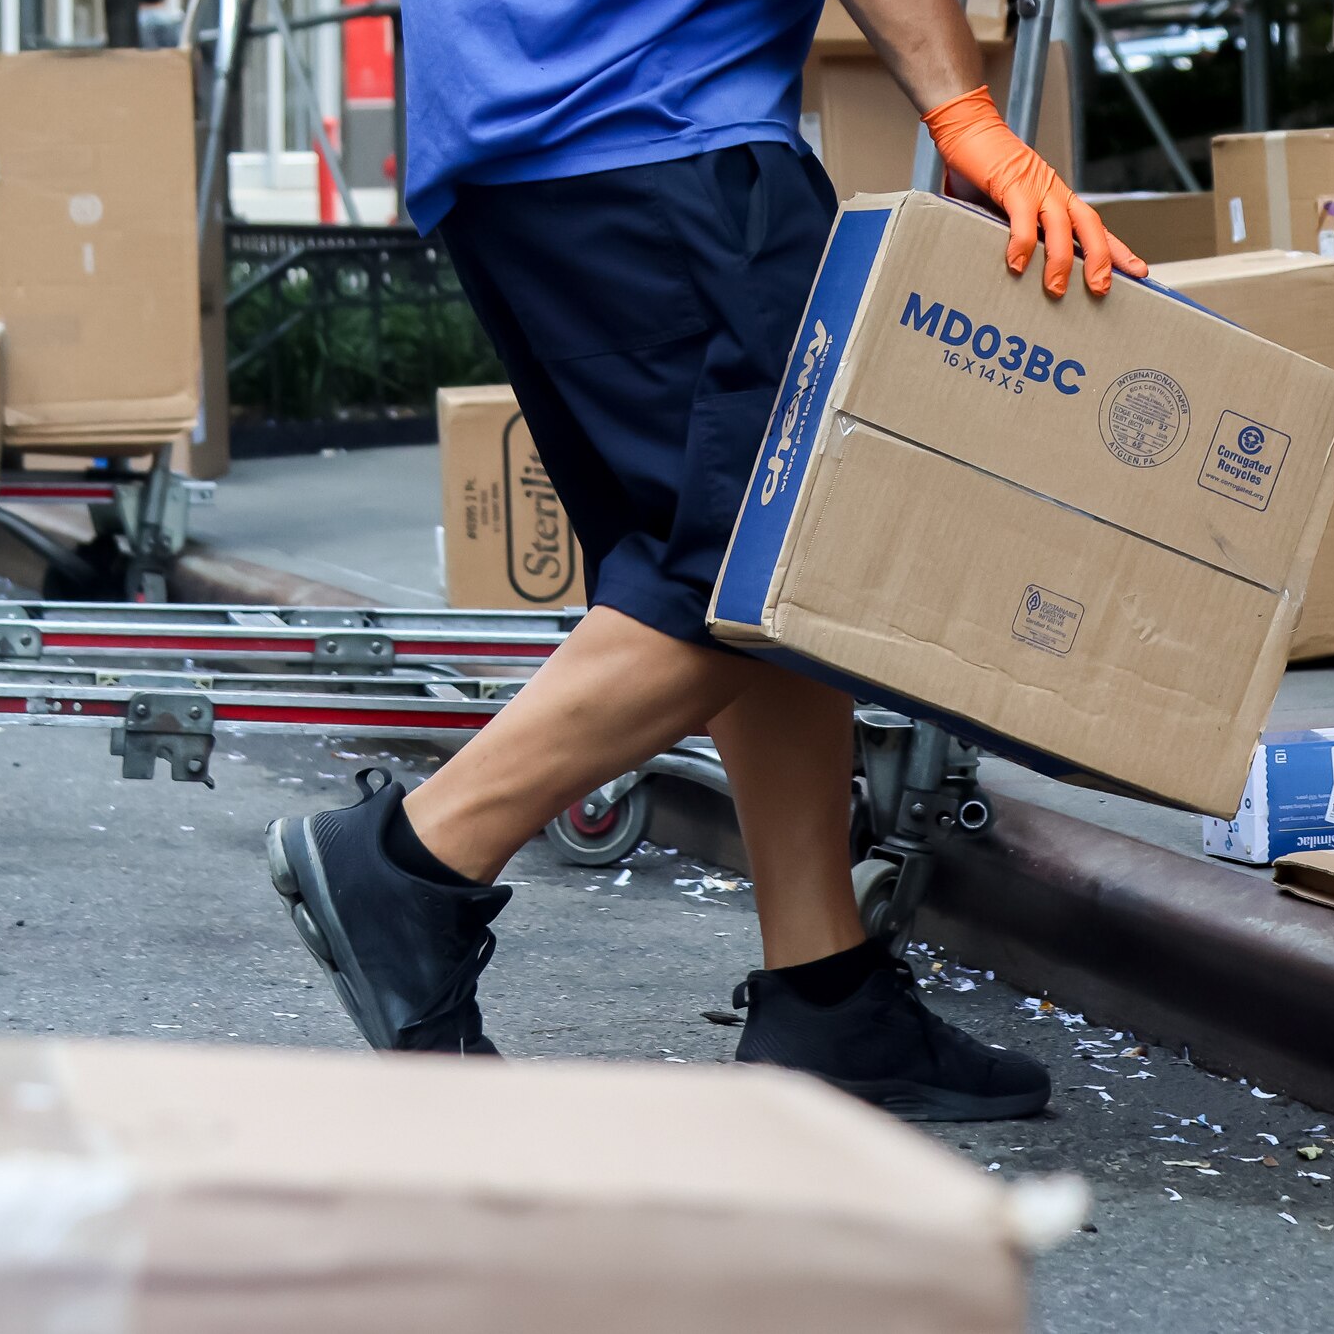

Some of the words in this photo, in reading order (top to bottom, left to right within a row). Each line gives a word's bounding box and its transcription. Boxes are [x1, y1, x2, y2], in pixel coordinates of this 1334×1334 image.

[899, 291, 1086, 395] MD03BC
[802, 372, 820, 417] lovers
[818, 333, 834, 369] shop
[943, 349, 961, 367] 16
[961, 357, 976, 375] X
[978, 364, 996, 383] 14
[997, 372, 1012, 390] X
[1013, 380, 1025, 395] 5
[1116, 371, 1176, 392] INTERNATIONAL
[1174, 389, 1188, 415] PAPER
[1112, 412, 1127, 423] TEST
[1114, 405, 1131, 417] EDGE
[1132, 412, 1155, 426] CRUSH
[1143, 457, 1156, 466] PA
[1217, 444, 1272, 476] Corrugated
[1217, 458, 1262, 486] Recycles
[1205, 472, 1265, 502] www.corrugated.org
[520, 452, 562, 580] Sterili
